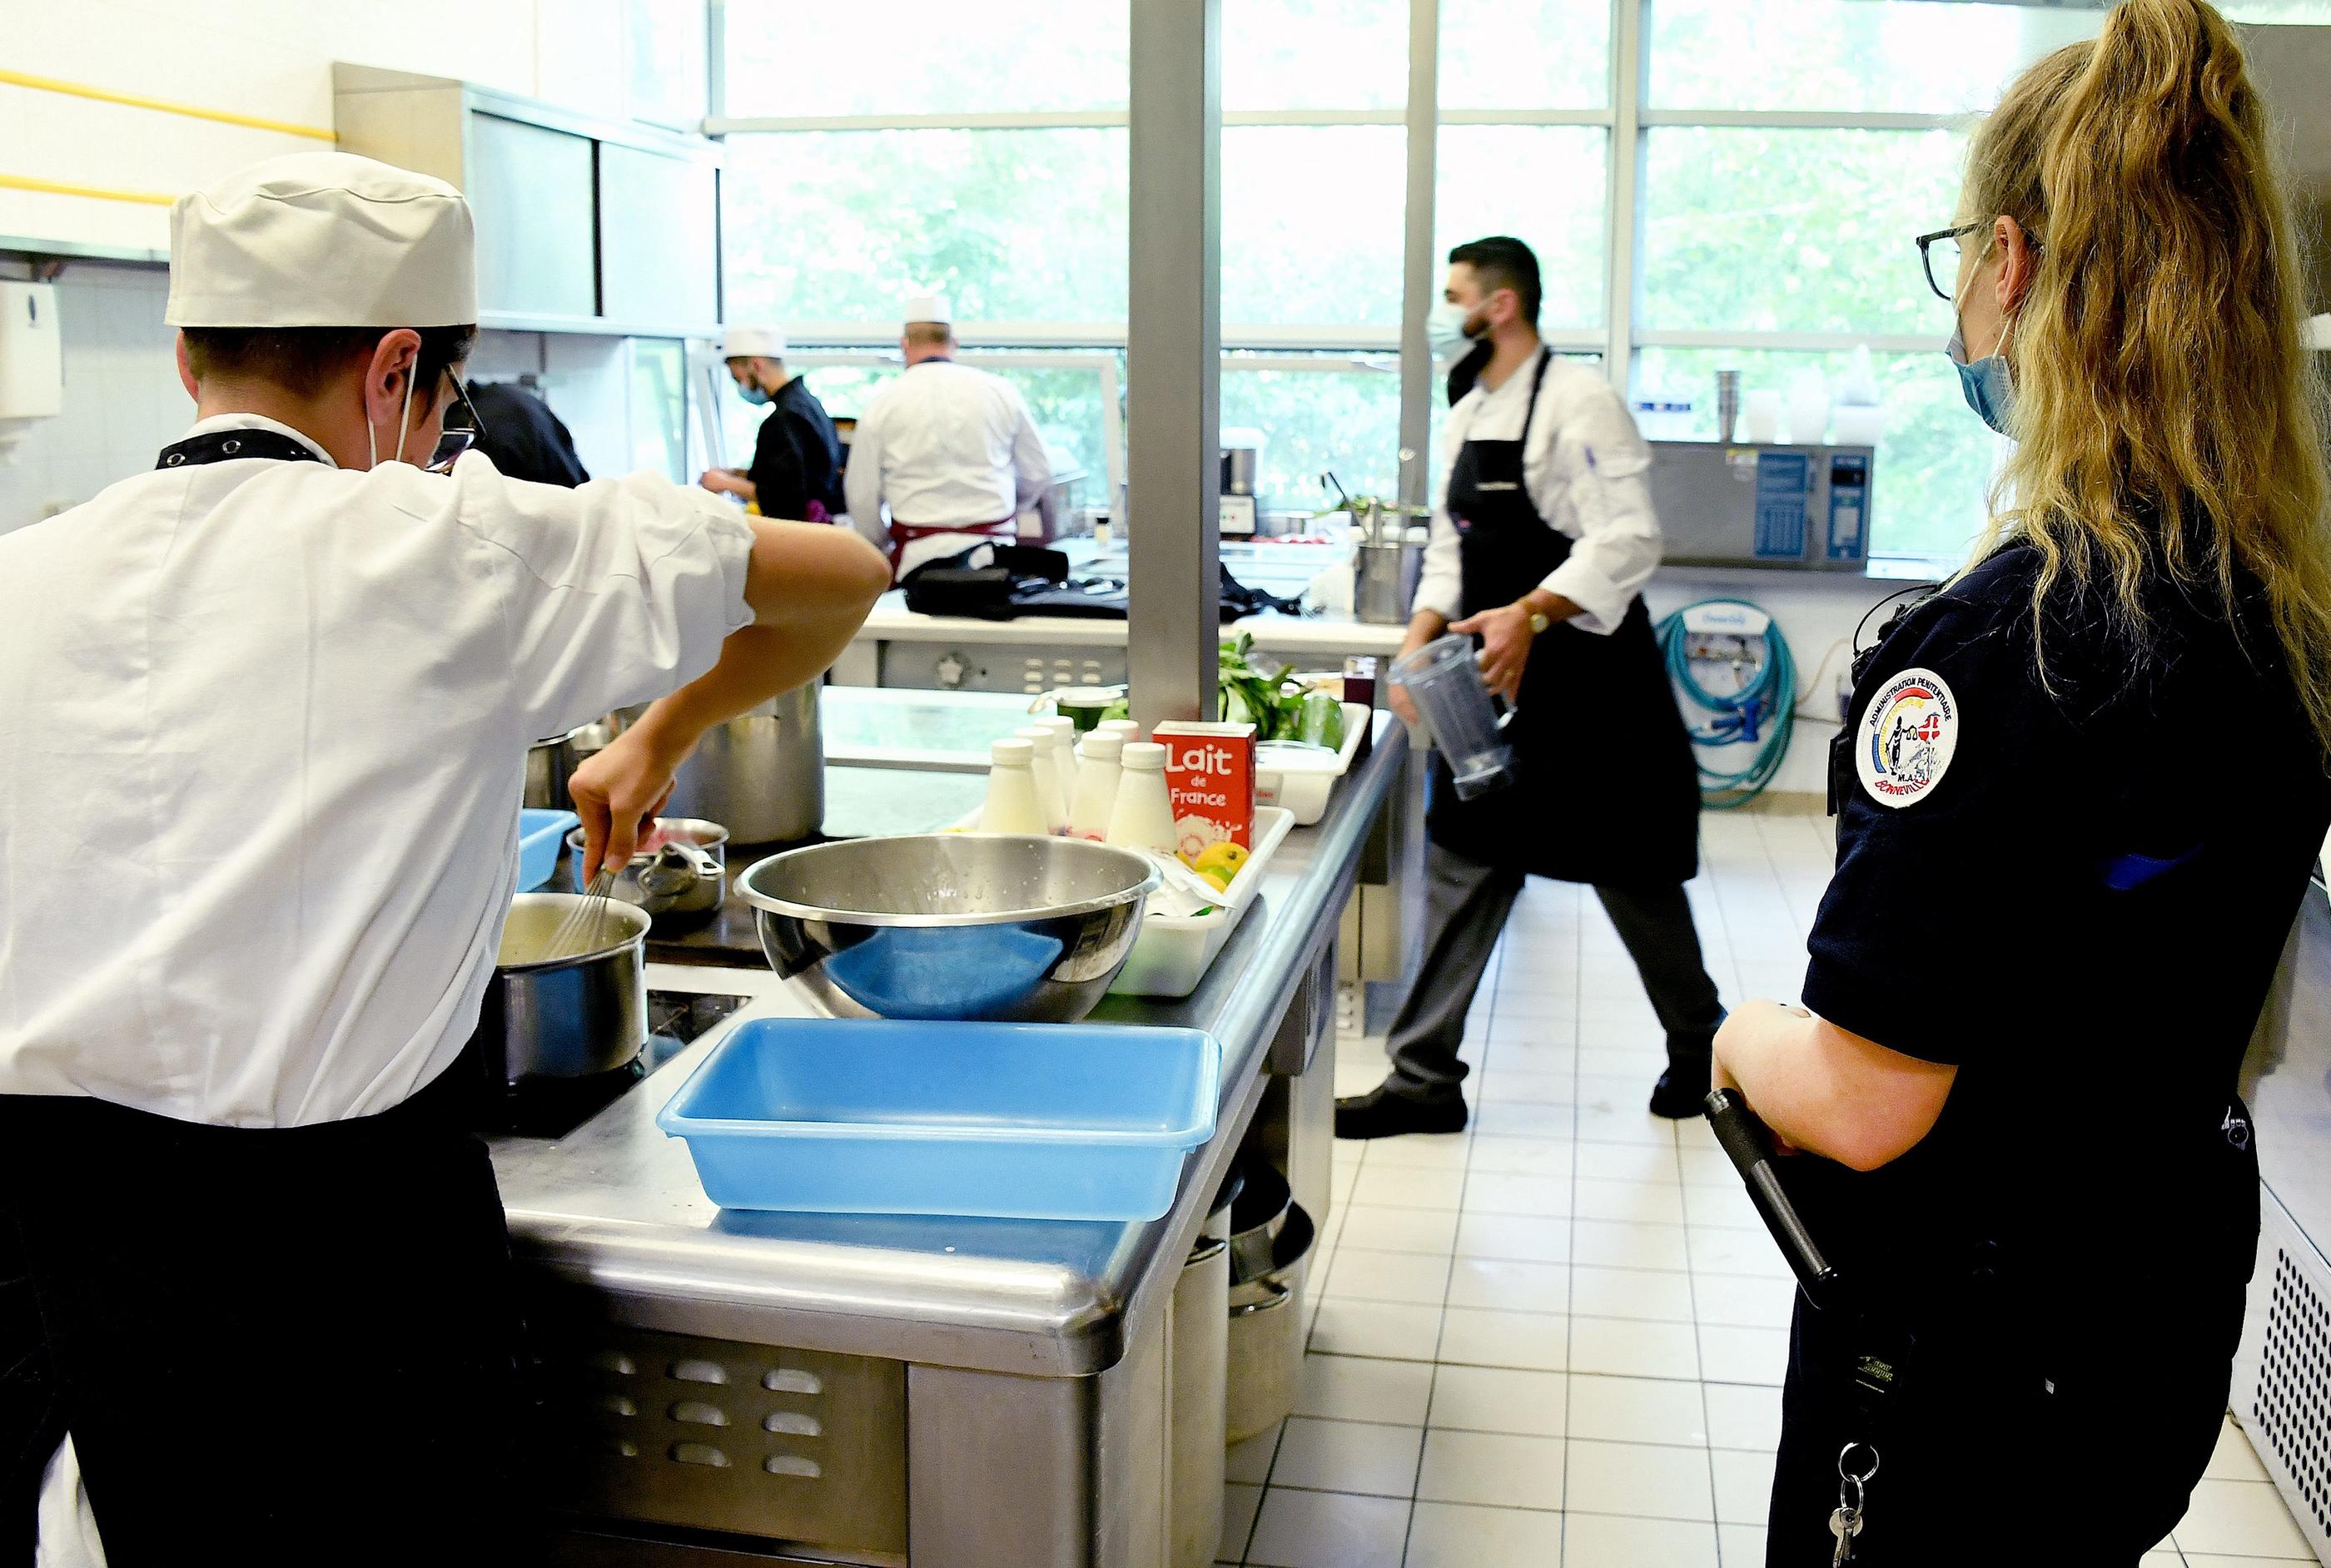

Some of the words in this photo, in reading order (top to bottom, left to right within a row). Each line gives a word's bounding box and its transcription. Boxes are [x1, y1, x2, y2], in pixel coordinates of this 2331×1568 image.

[1869, 677, 1916, 727] ADMINISTRATION
[1166, 742, 1233, 776] Lait
[1190, 775, 1207, 787] de
[1874, 778, 1931, 796] BONNEVILLE
[1170, 787, 1226, 806] France
